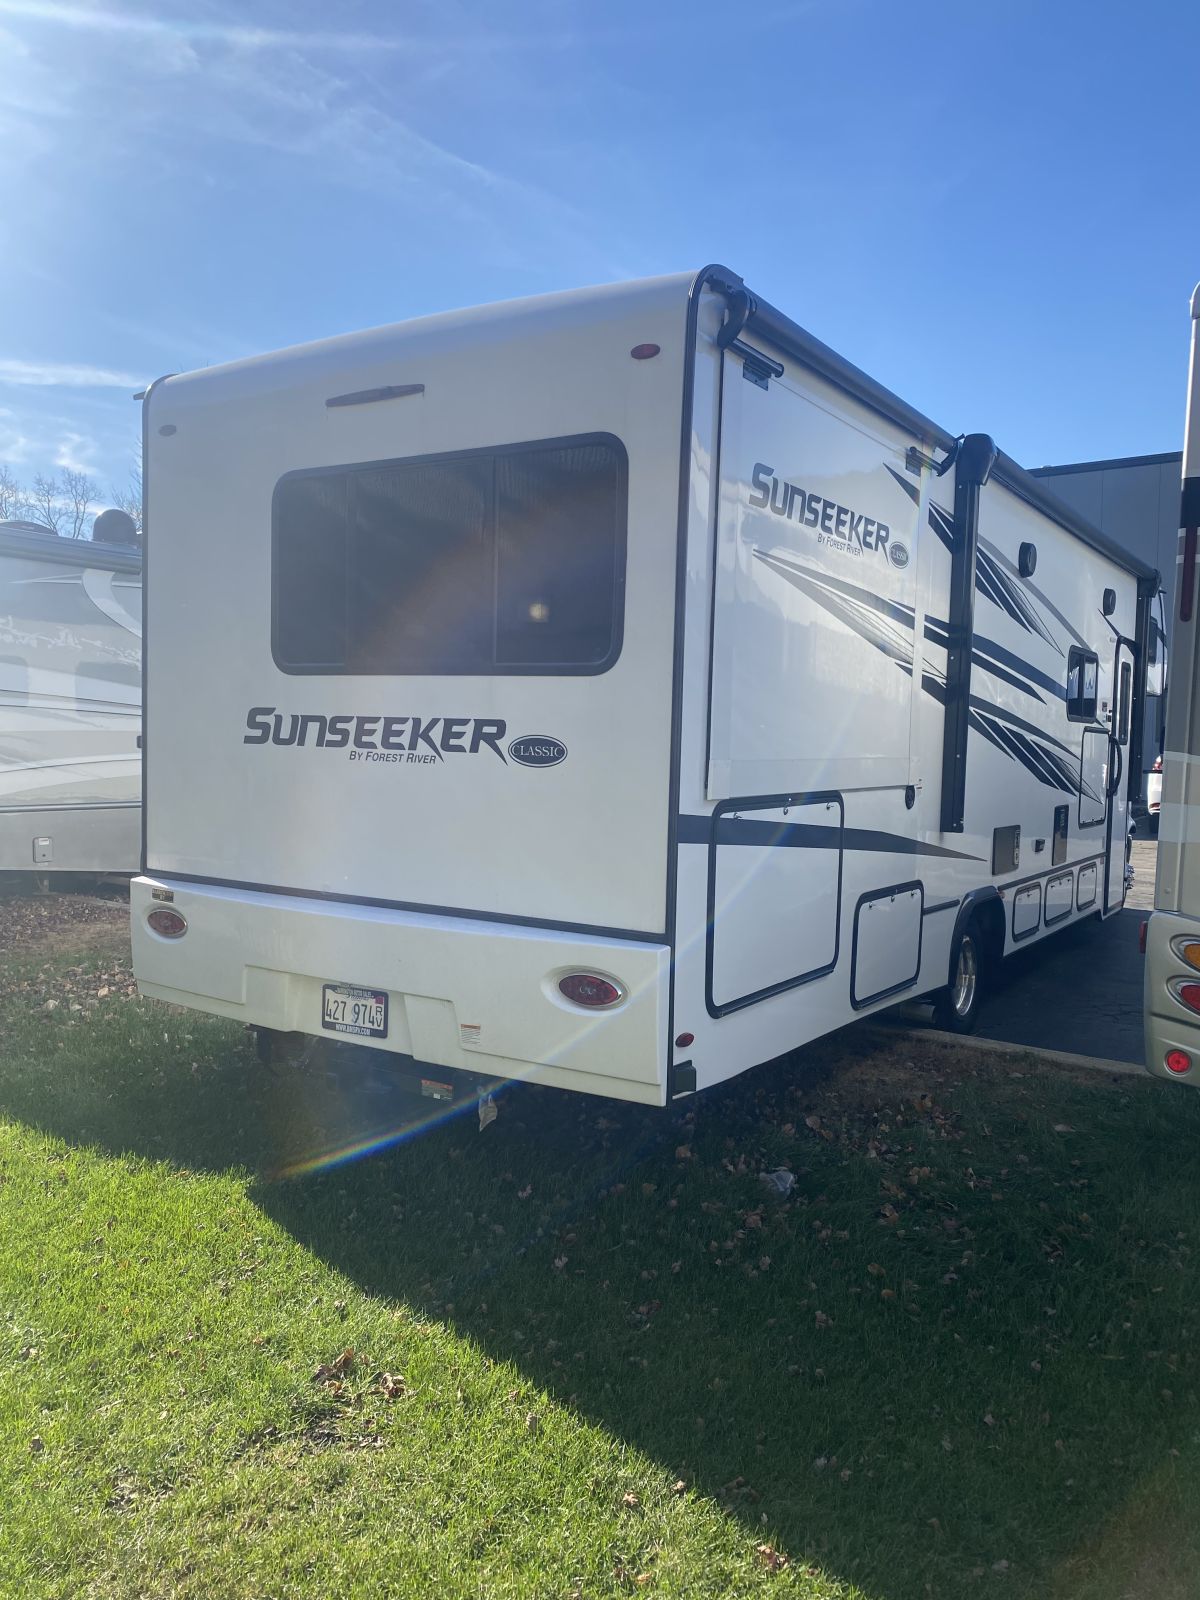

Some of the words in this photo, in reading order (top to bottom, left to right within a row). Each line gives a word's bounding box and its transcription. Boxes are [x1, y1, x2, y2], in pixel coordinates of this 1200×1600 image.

[512, 744, 565, 758] CLASSIC
[326, 998, 347, 1022] 427
[353, 1003, 375, 1026] 974
